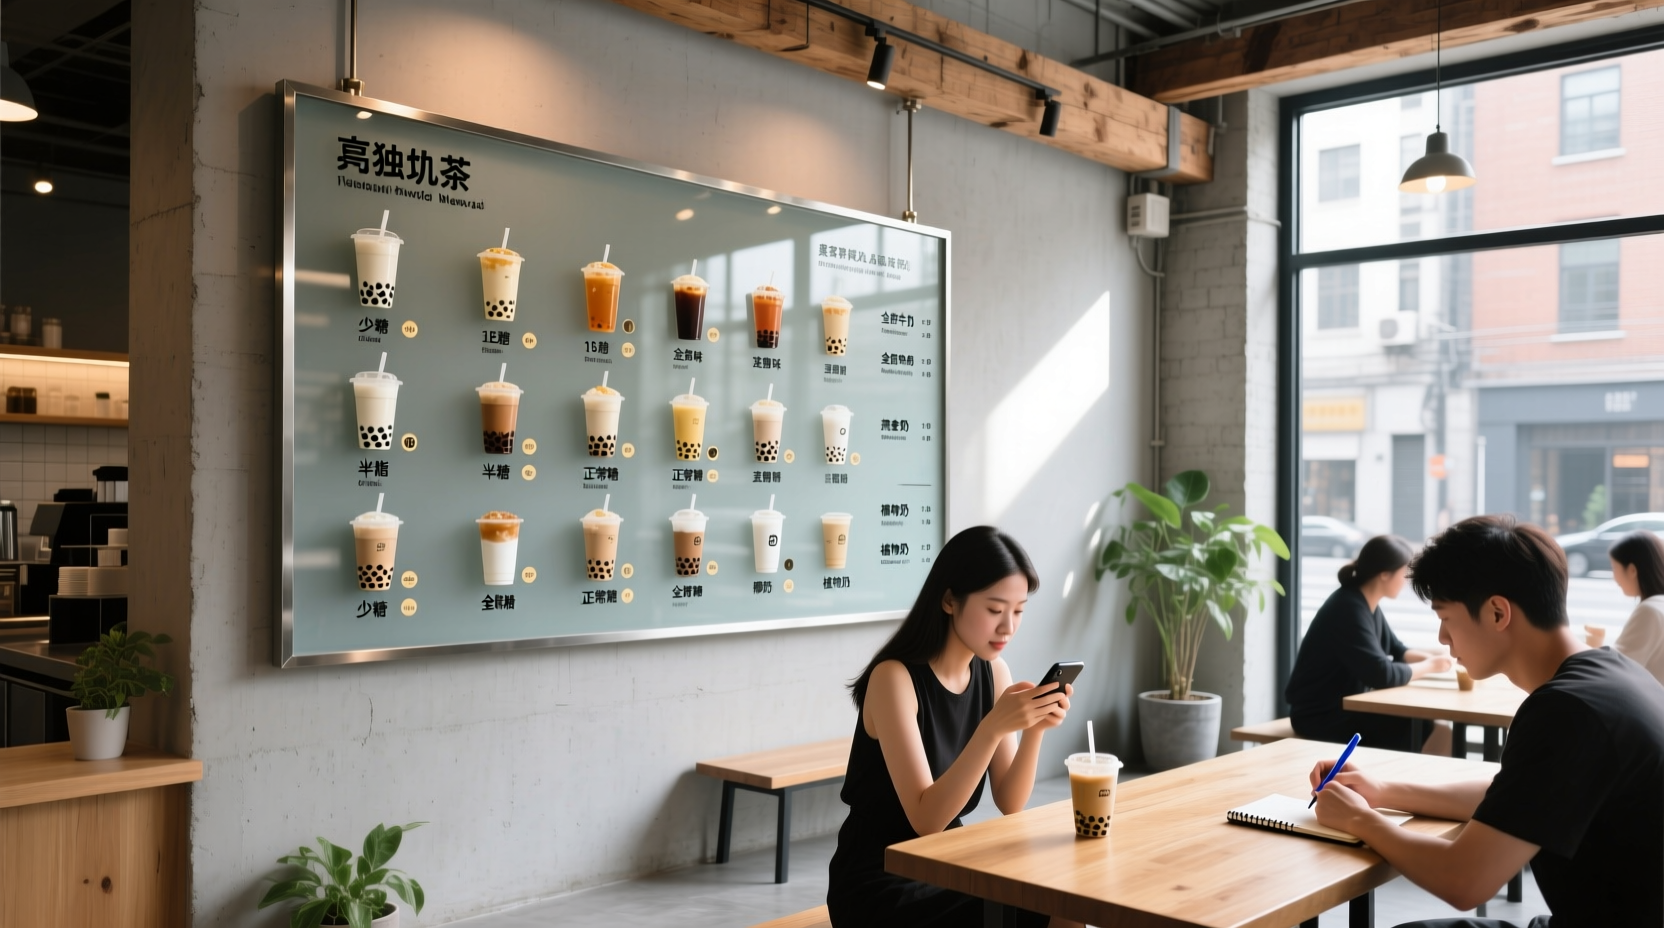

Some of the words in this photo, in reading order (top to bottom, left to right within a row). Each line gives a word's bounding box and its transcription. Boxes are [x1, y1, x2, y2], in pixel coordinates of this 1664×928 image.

[358, 317, 389, 334] 少糖
[482, 462, 511, 480] 半糖
[356, 600, 388, 618] 少糖
